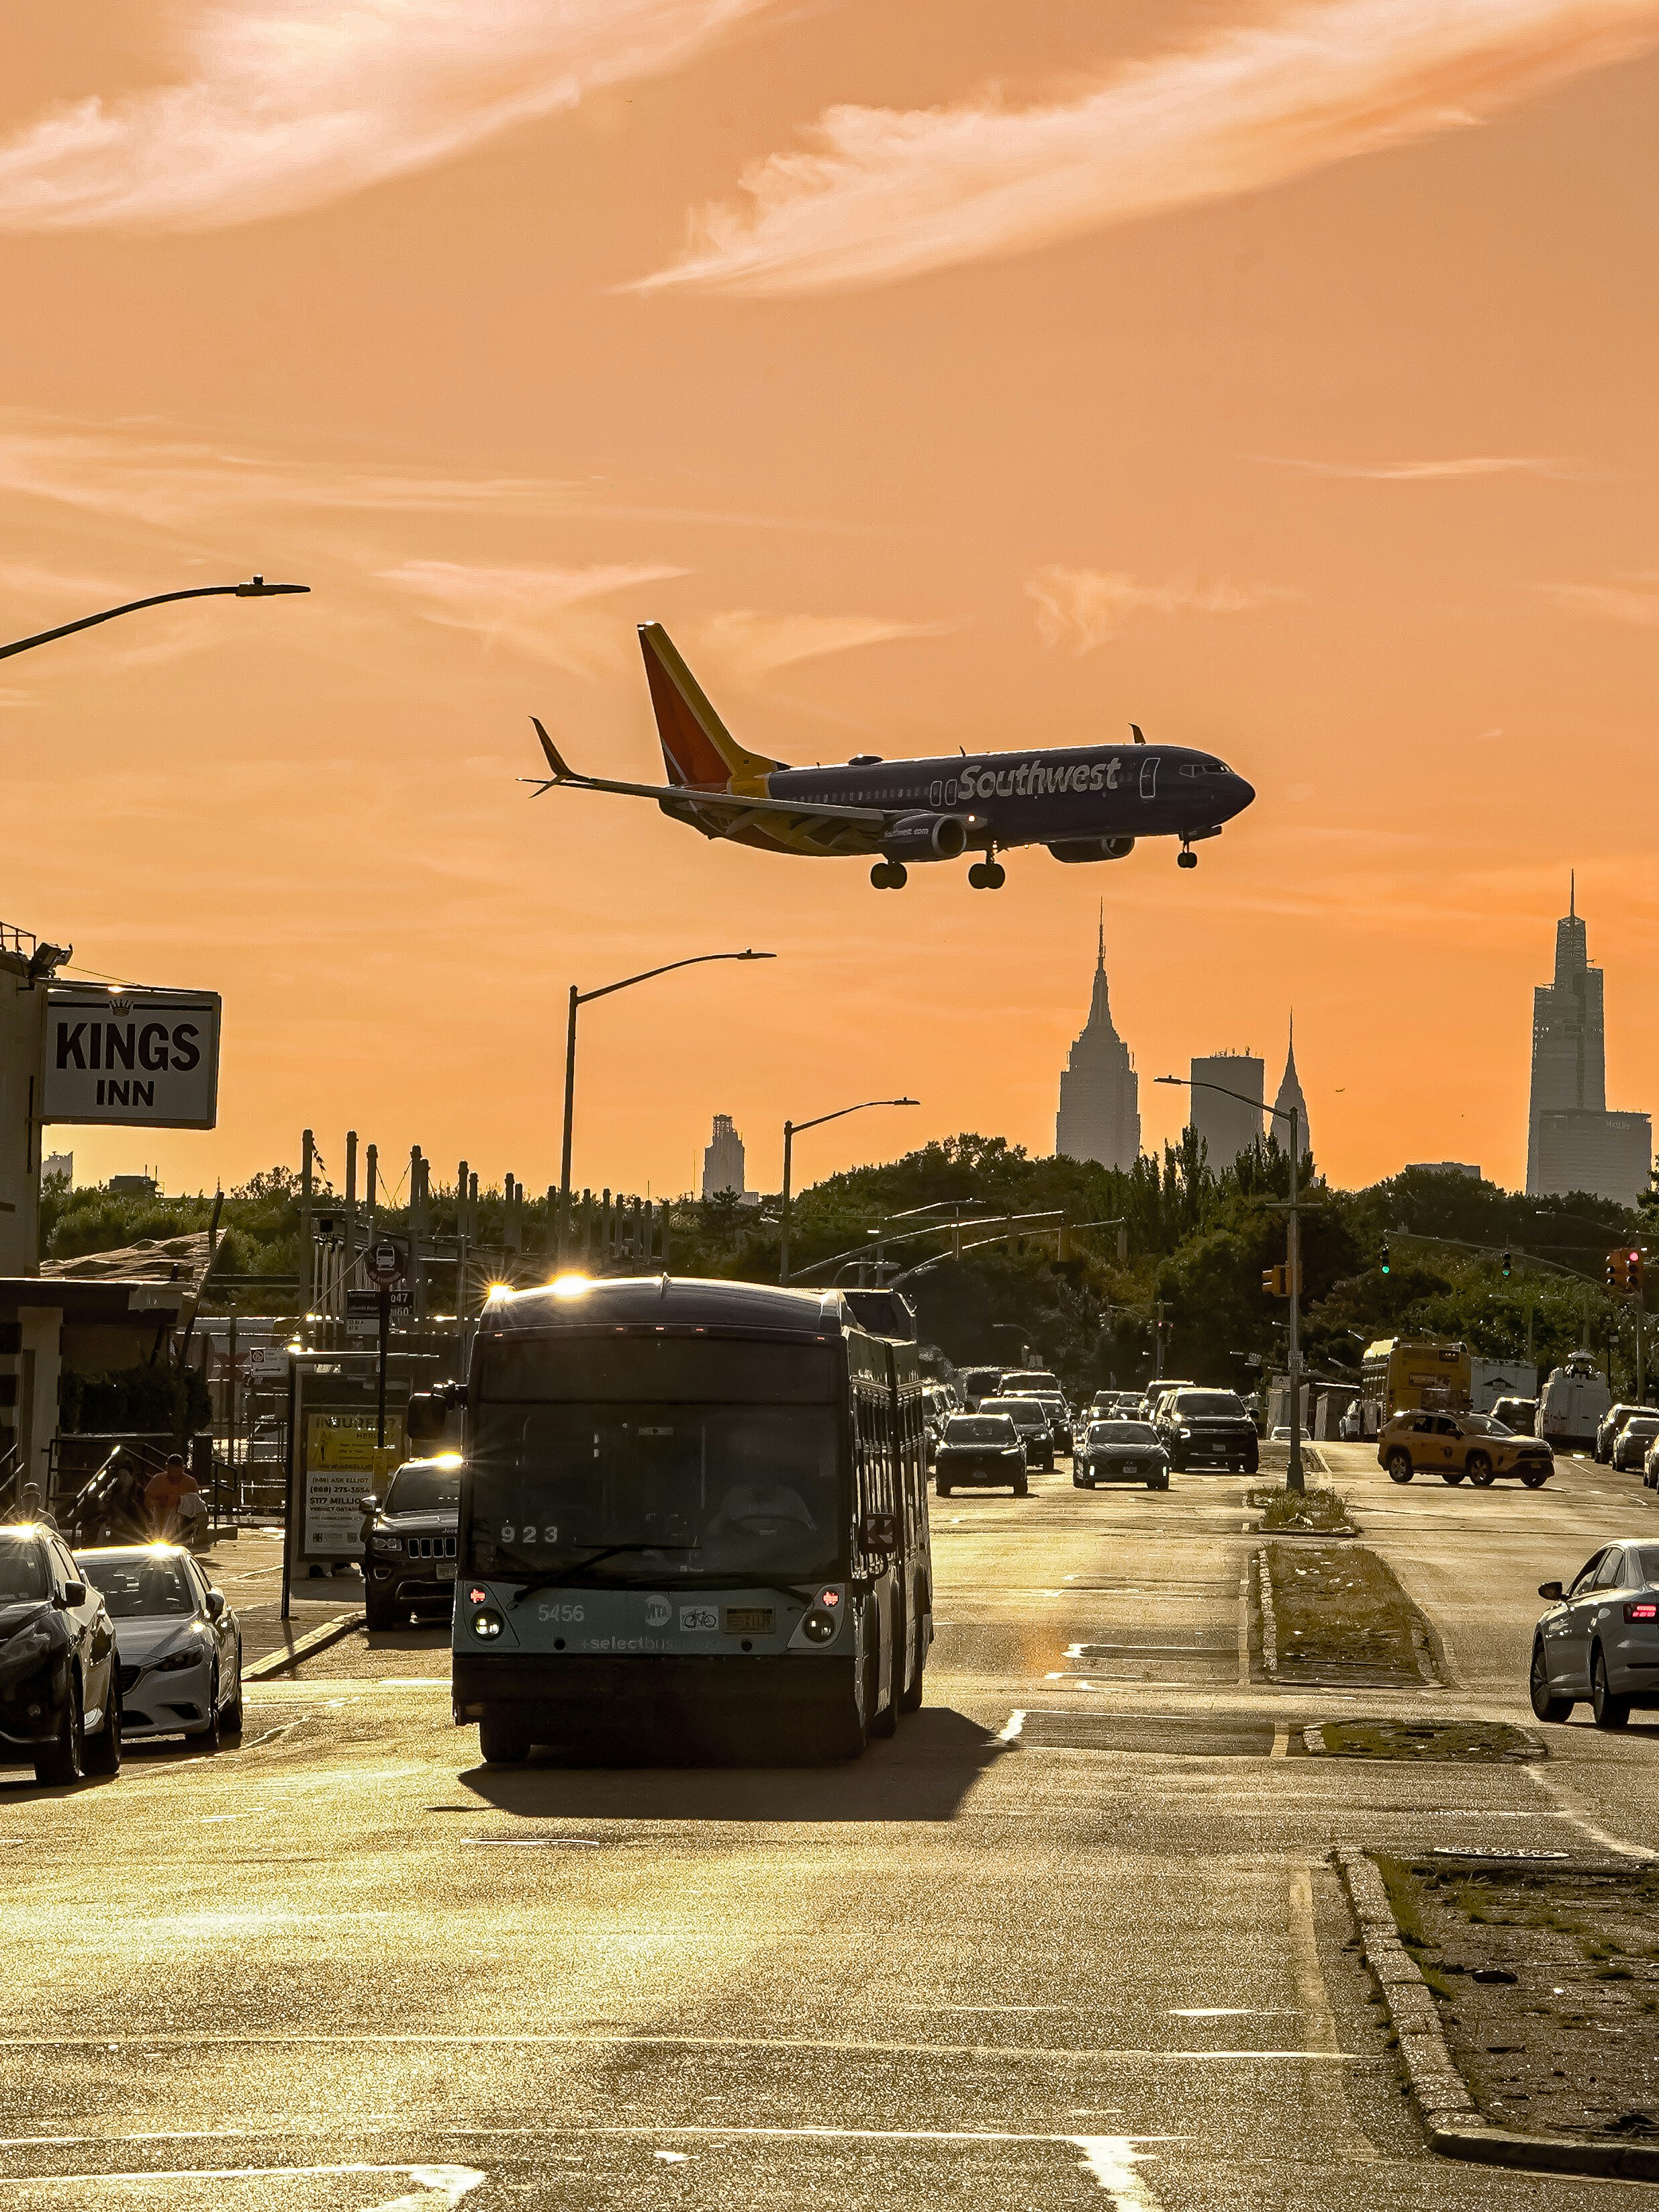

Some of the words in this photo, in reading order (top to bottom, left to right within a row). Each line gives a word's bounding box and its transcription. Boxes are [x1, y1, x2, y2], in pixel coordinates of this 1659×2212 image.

[958, 757, 1121, 800] Southwest
[56, 1022, 200, 1071] KINGS
[96, 1079, 155, 1107] INN
[391, 1293, 408, 1303] Q47
[390, 1307, 409, 1316] M60
[501, 1526, 557, 1542] 923
[537, 1604, 584, 1622] 5456
